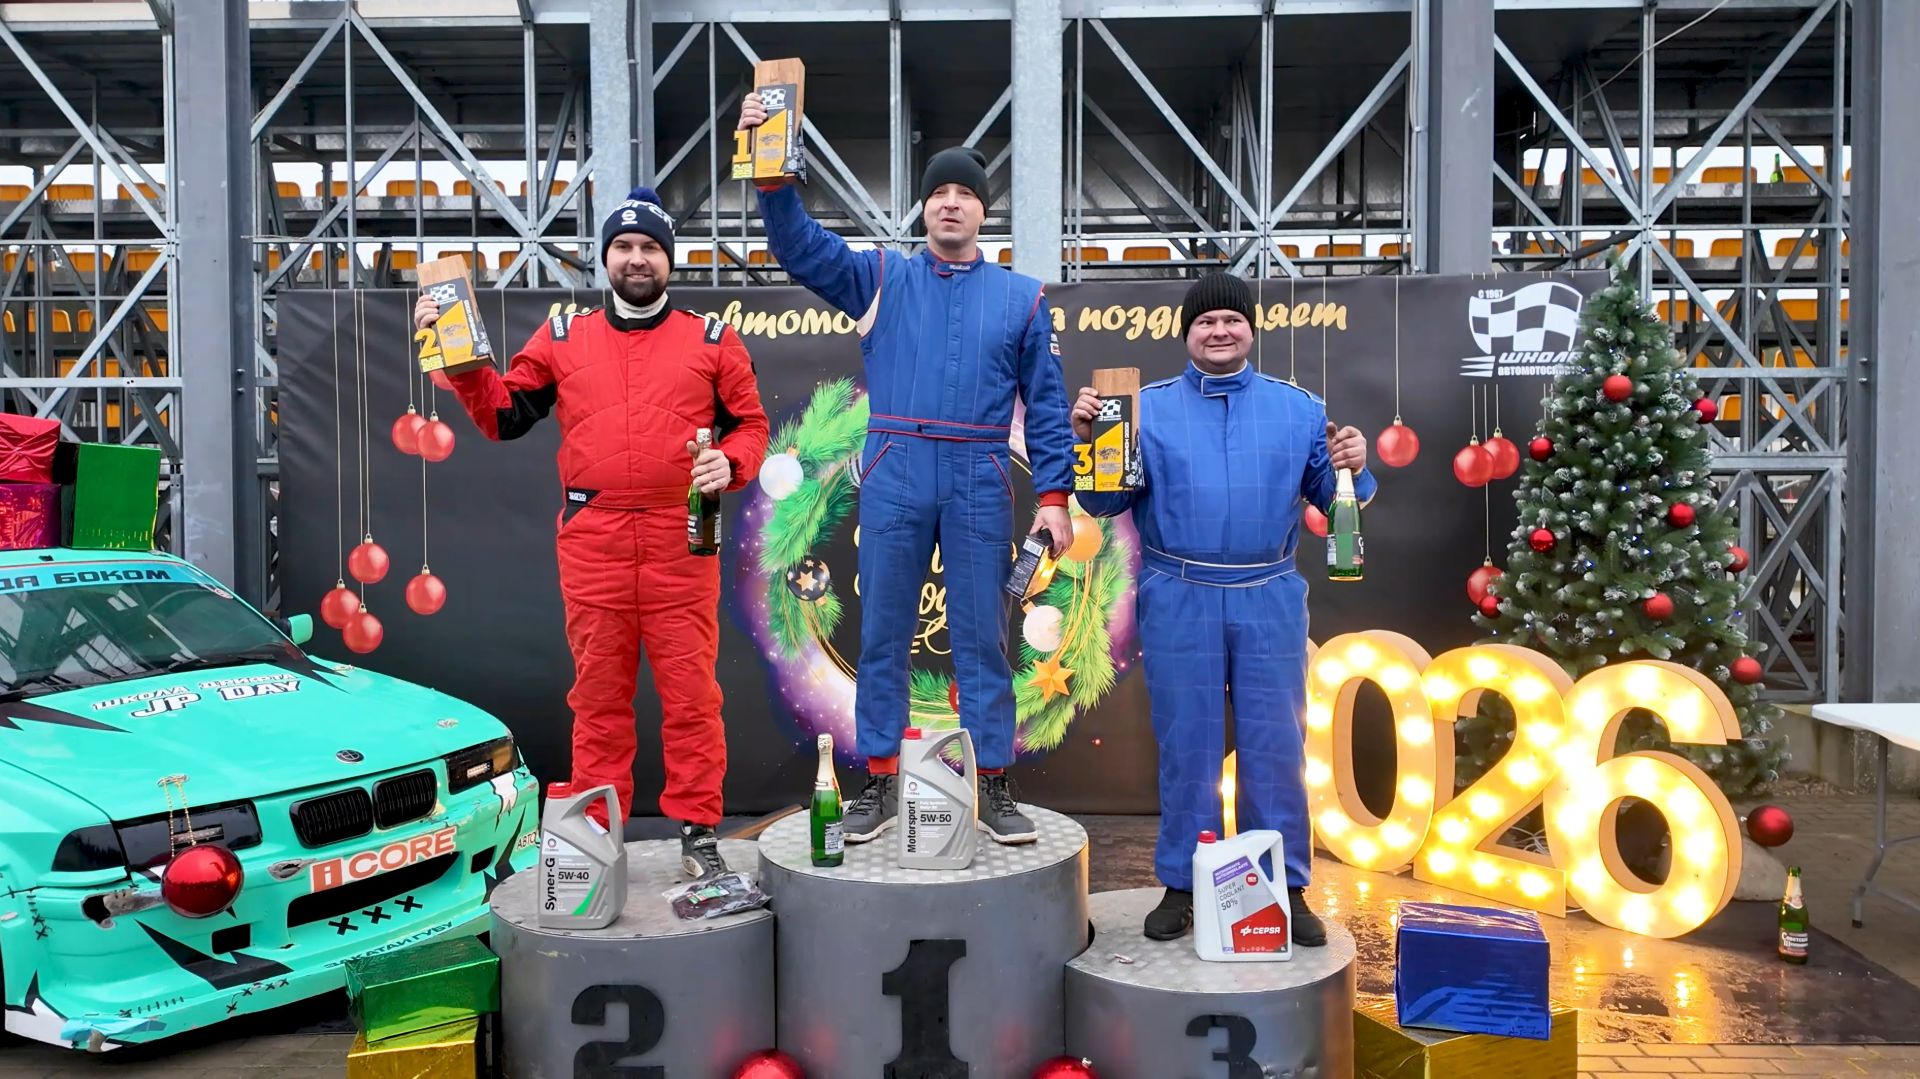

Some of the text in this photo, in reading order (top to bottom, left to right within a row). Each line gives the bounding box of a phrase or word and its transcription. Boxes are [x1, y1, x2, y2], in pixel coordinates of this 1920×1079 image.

[732, 129, 751, 163] 1
[414, 328, 441, 358] 2
[1072, 443, 1094, 475] 3
[54, 569, 171, 584] БОКОМ
[131, 680, 301, 718] JP DAY
[906, 800, 917, 853] Motorsport
[920, 813, 952, 823] 5W-50
[348, 827, 456, 880] CORE
[558, 871, 590, 881] 5W-40
[1217, 881, 1236, 895] SUPER
[1219, 885, 1245, 902] COOLANT
[1221, 899, 1239, 911] 50%
[1252, 926, 1281, 935] CEPSA
[882, 939, 968, 1079] 1
[571, 984, 665, 1079] 2
[1185, 1014, 1263, 1079] 3
